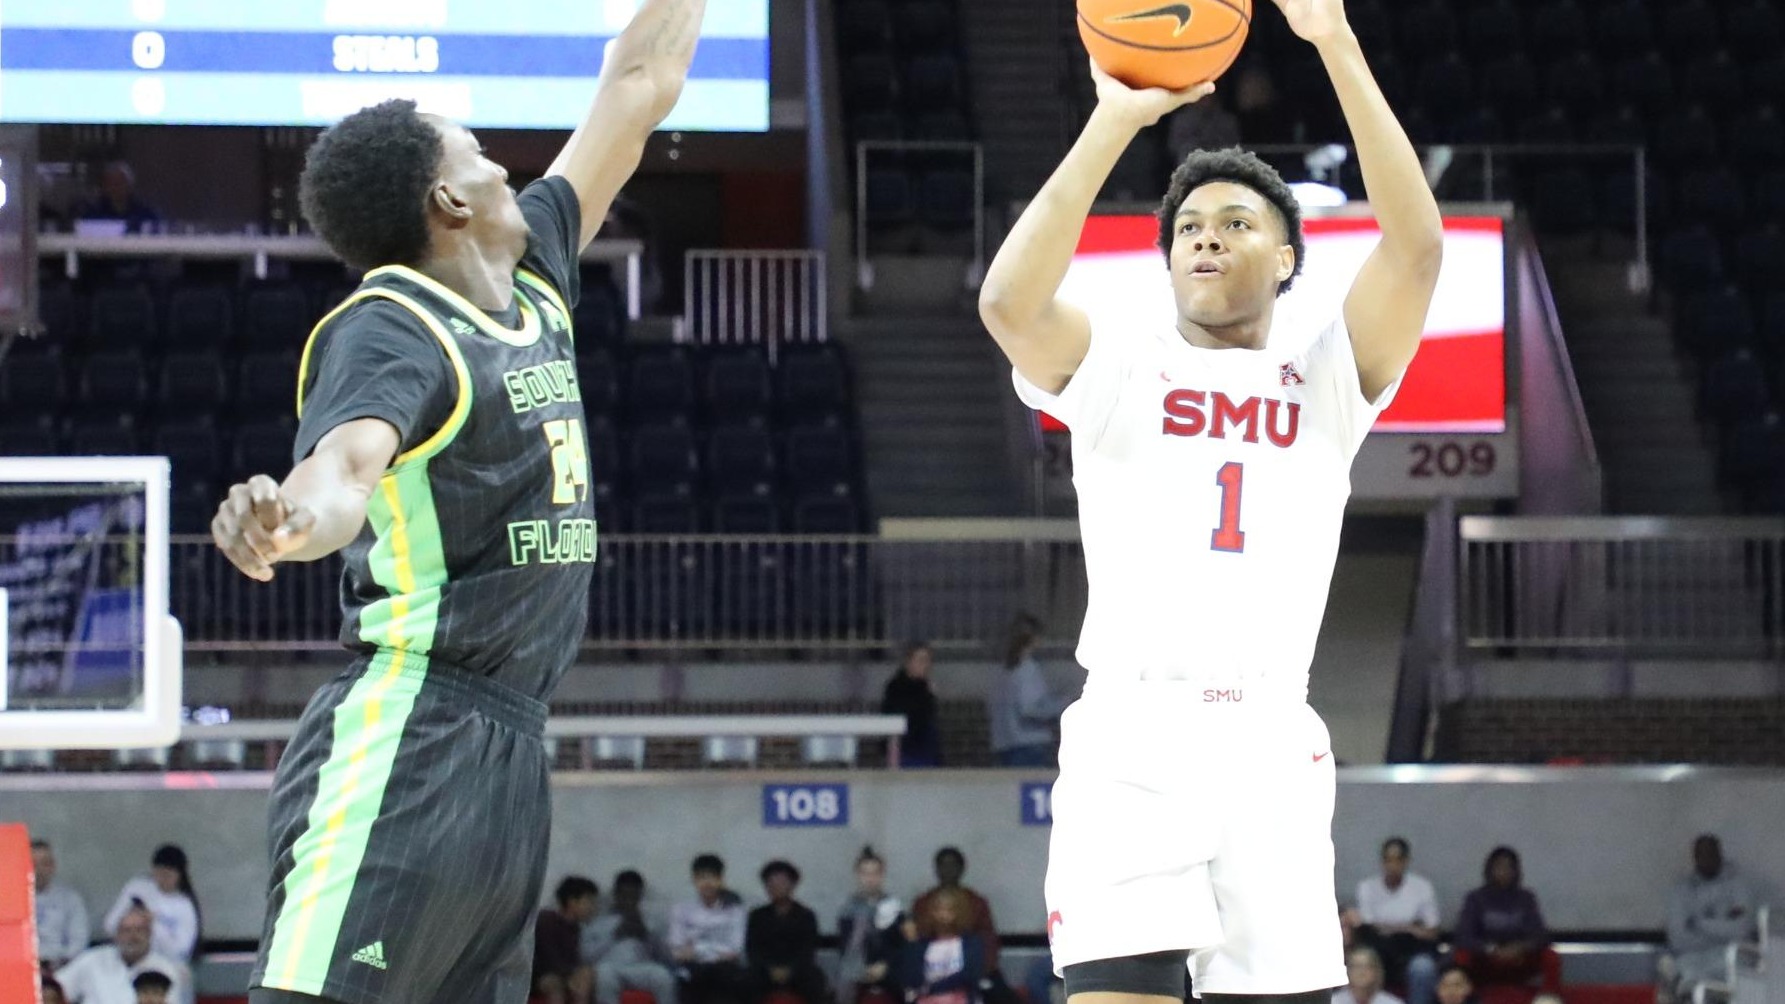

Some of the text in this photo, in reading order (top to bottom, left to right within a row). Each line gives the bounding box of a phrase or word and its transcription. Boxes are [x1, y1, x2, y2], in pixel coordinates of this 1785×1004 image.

[332, 34, 440, 73] STEALS
[1162, 388, 1301, 448] SMU
[542, 418, 588, 504] 24
[1409, 441, 1496, 478] 209
[1210, 461, 1245, 553] 1
[1203, 689, 1243, 703] SMU
[772, 789, 840, 820] 108
